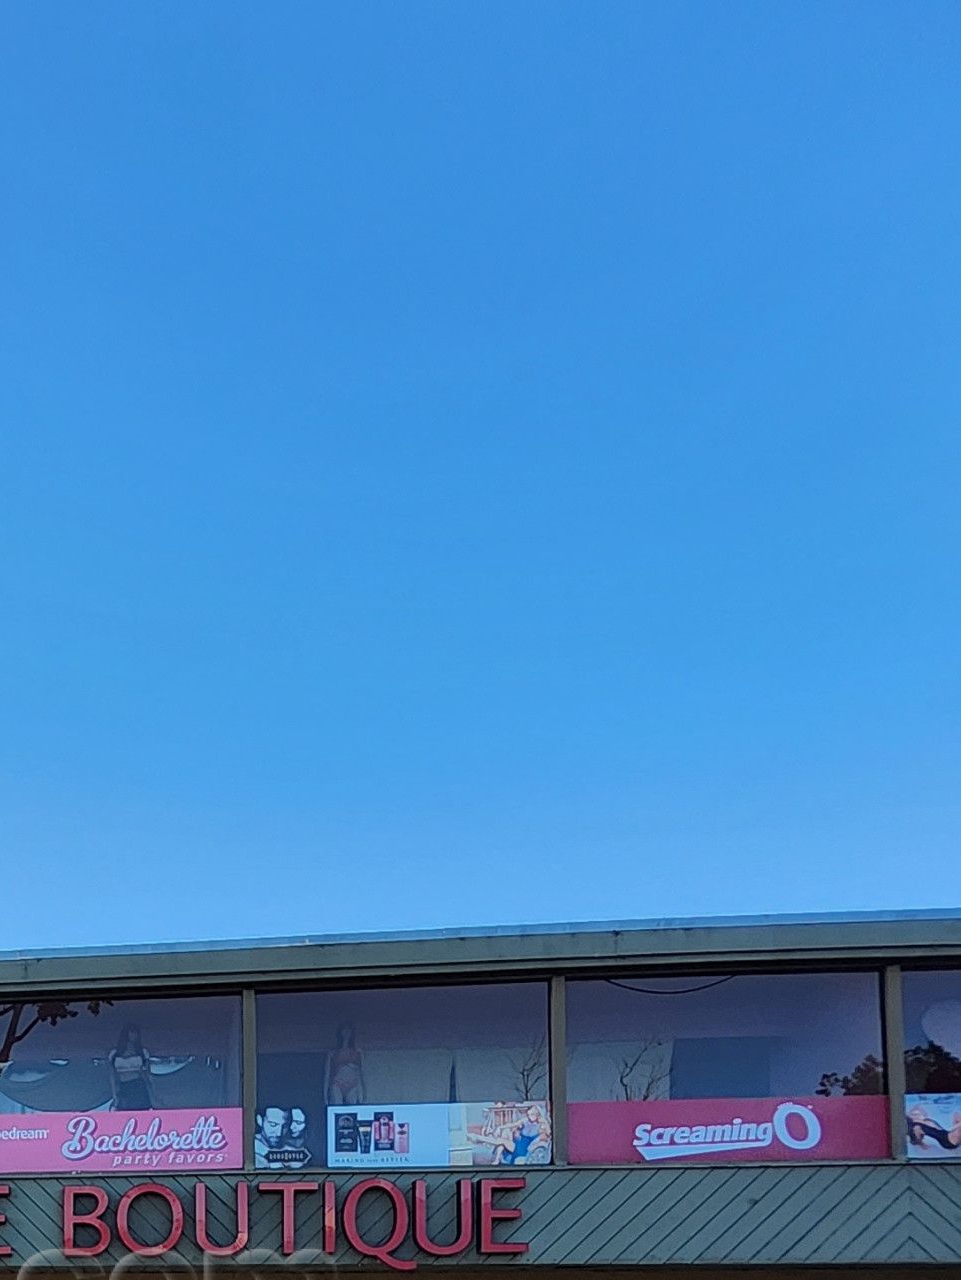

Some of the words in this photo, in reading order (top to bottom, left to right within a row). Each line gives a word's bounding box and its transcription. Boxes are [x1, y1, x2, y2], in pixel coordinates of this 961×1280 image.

[61, 1115, 228, 1161] Bachelorette
[633, 1118, 772, 1147] Screaming
[772, 1102, 822, 1150] O
[112, 1155, 160, 1168] party
[168, 1152, 225, 1165] favors
[61, 1177, 530, 1272] BOUTIQUE
